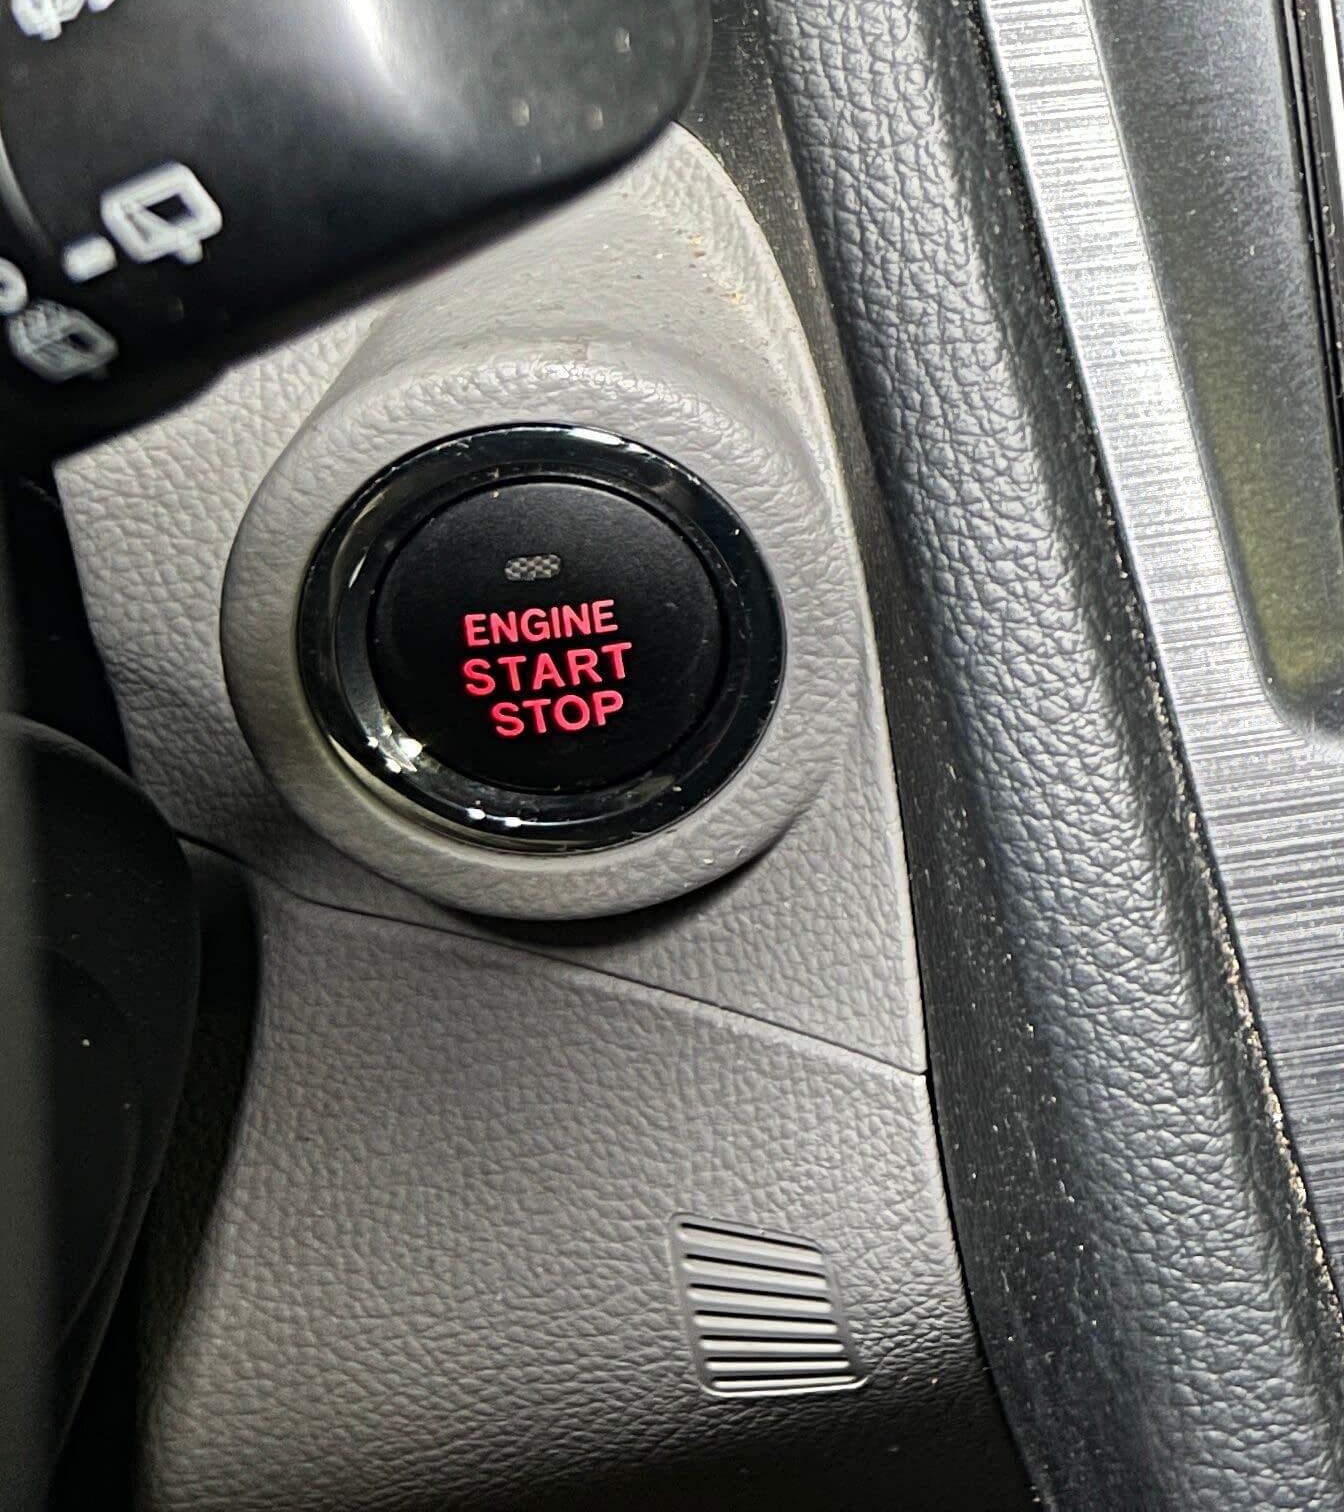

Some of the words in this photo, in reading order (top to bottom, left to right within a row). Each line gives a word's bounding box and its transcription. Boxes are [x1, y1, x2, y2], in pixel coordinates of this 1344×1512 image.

[464, 599, 619, 647] ENGINE
[462, 642, 632, 696] START
[490, 689, 624, 737] STOP
